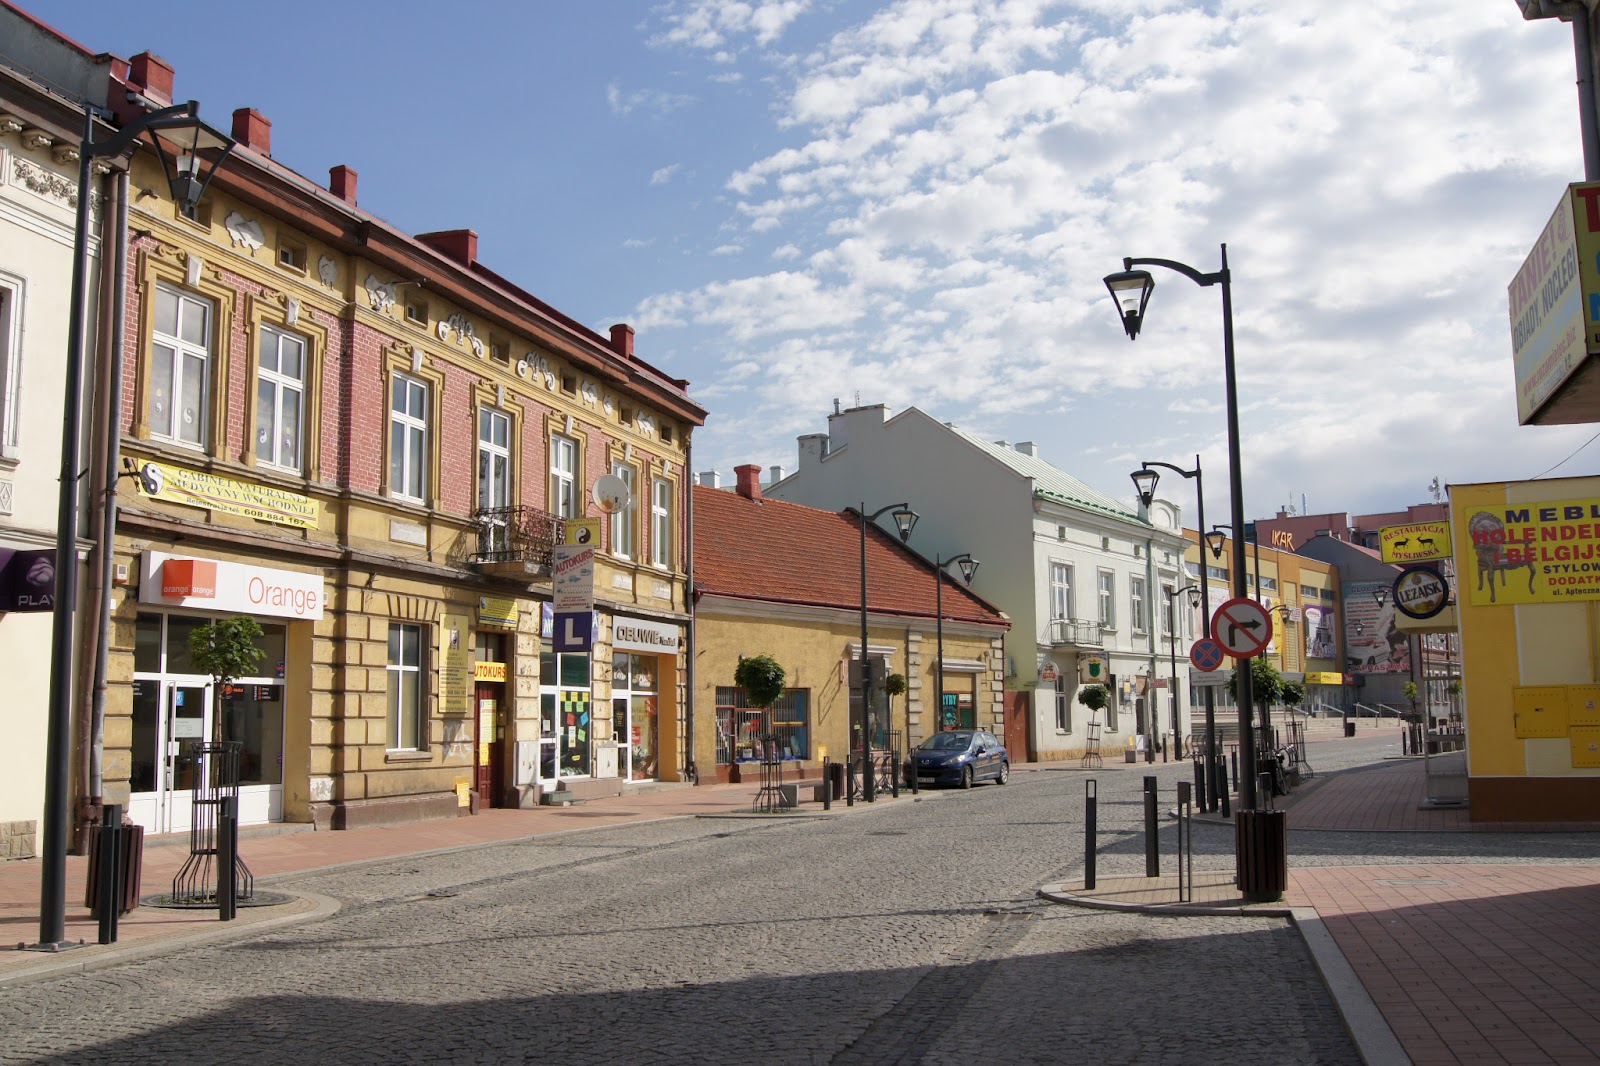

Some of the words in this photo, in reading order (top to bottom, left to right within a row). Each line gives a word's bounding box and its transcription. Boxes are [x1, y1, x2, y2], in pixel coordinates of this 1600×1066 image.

[1513, 297, 1542, 354] OBIADY,
[1542, 242, 1577, 317] NOCLEGI
[170, 477, 238, 499] MEDYCYNY
[242, 493, 315, 515] WSCHODNIEJ
[178, 469, 231, 488] GABINET
[236, 480, 308, 504] NATURALNEJ
[244, 508, 263, 518] 608
[266, 513, 285, 523] 884
[288, 517, 305, 526] 167
[1272, 529, 1295, 552] IKAR
[1384, 525, 1444, 542] RESTAURACJA
[555, 549, 594, 574] AUTOKURS
[1392, 547, 1440, 559] MYŚLIWSKA
[163, 585, 189, 594] orange
[192, 586, 214, 596] orange
[249, 576, 317, 615] Orange
[1566, 587, 1600, 596] Apteczna
[565, 618, 583, 645] L
[617, 625, 660, 645] OBUWIE
